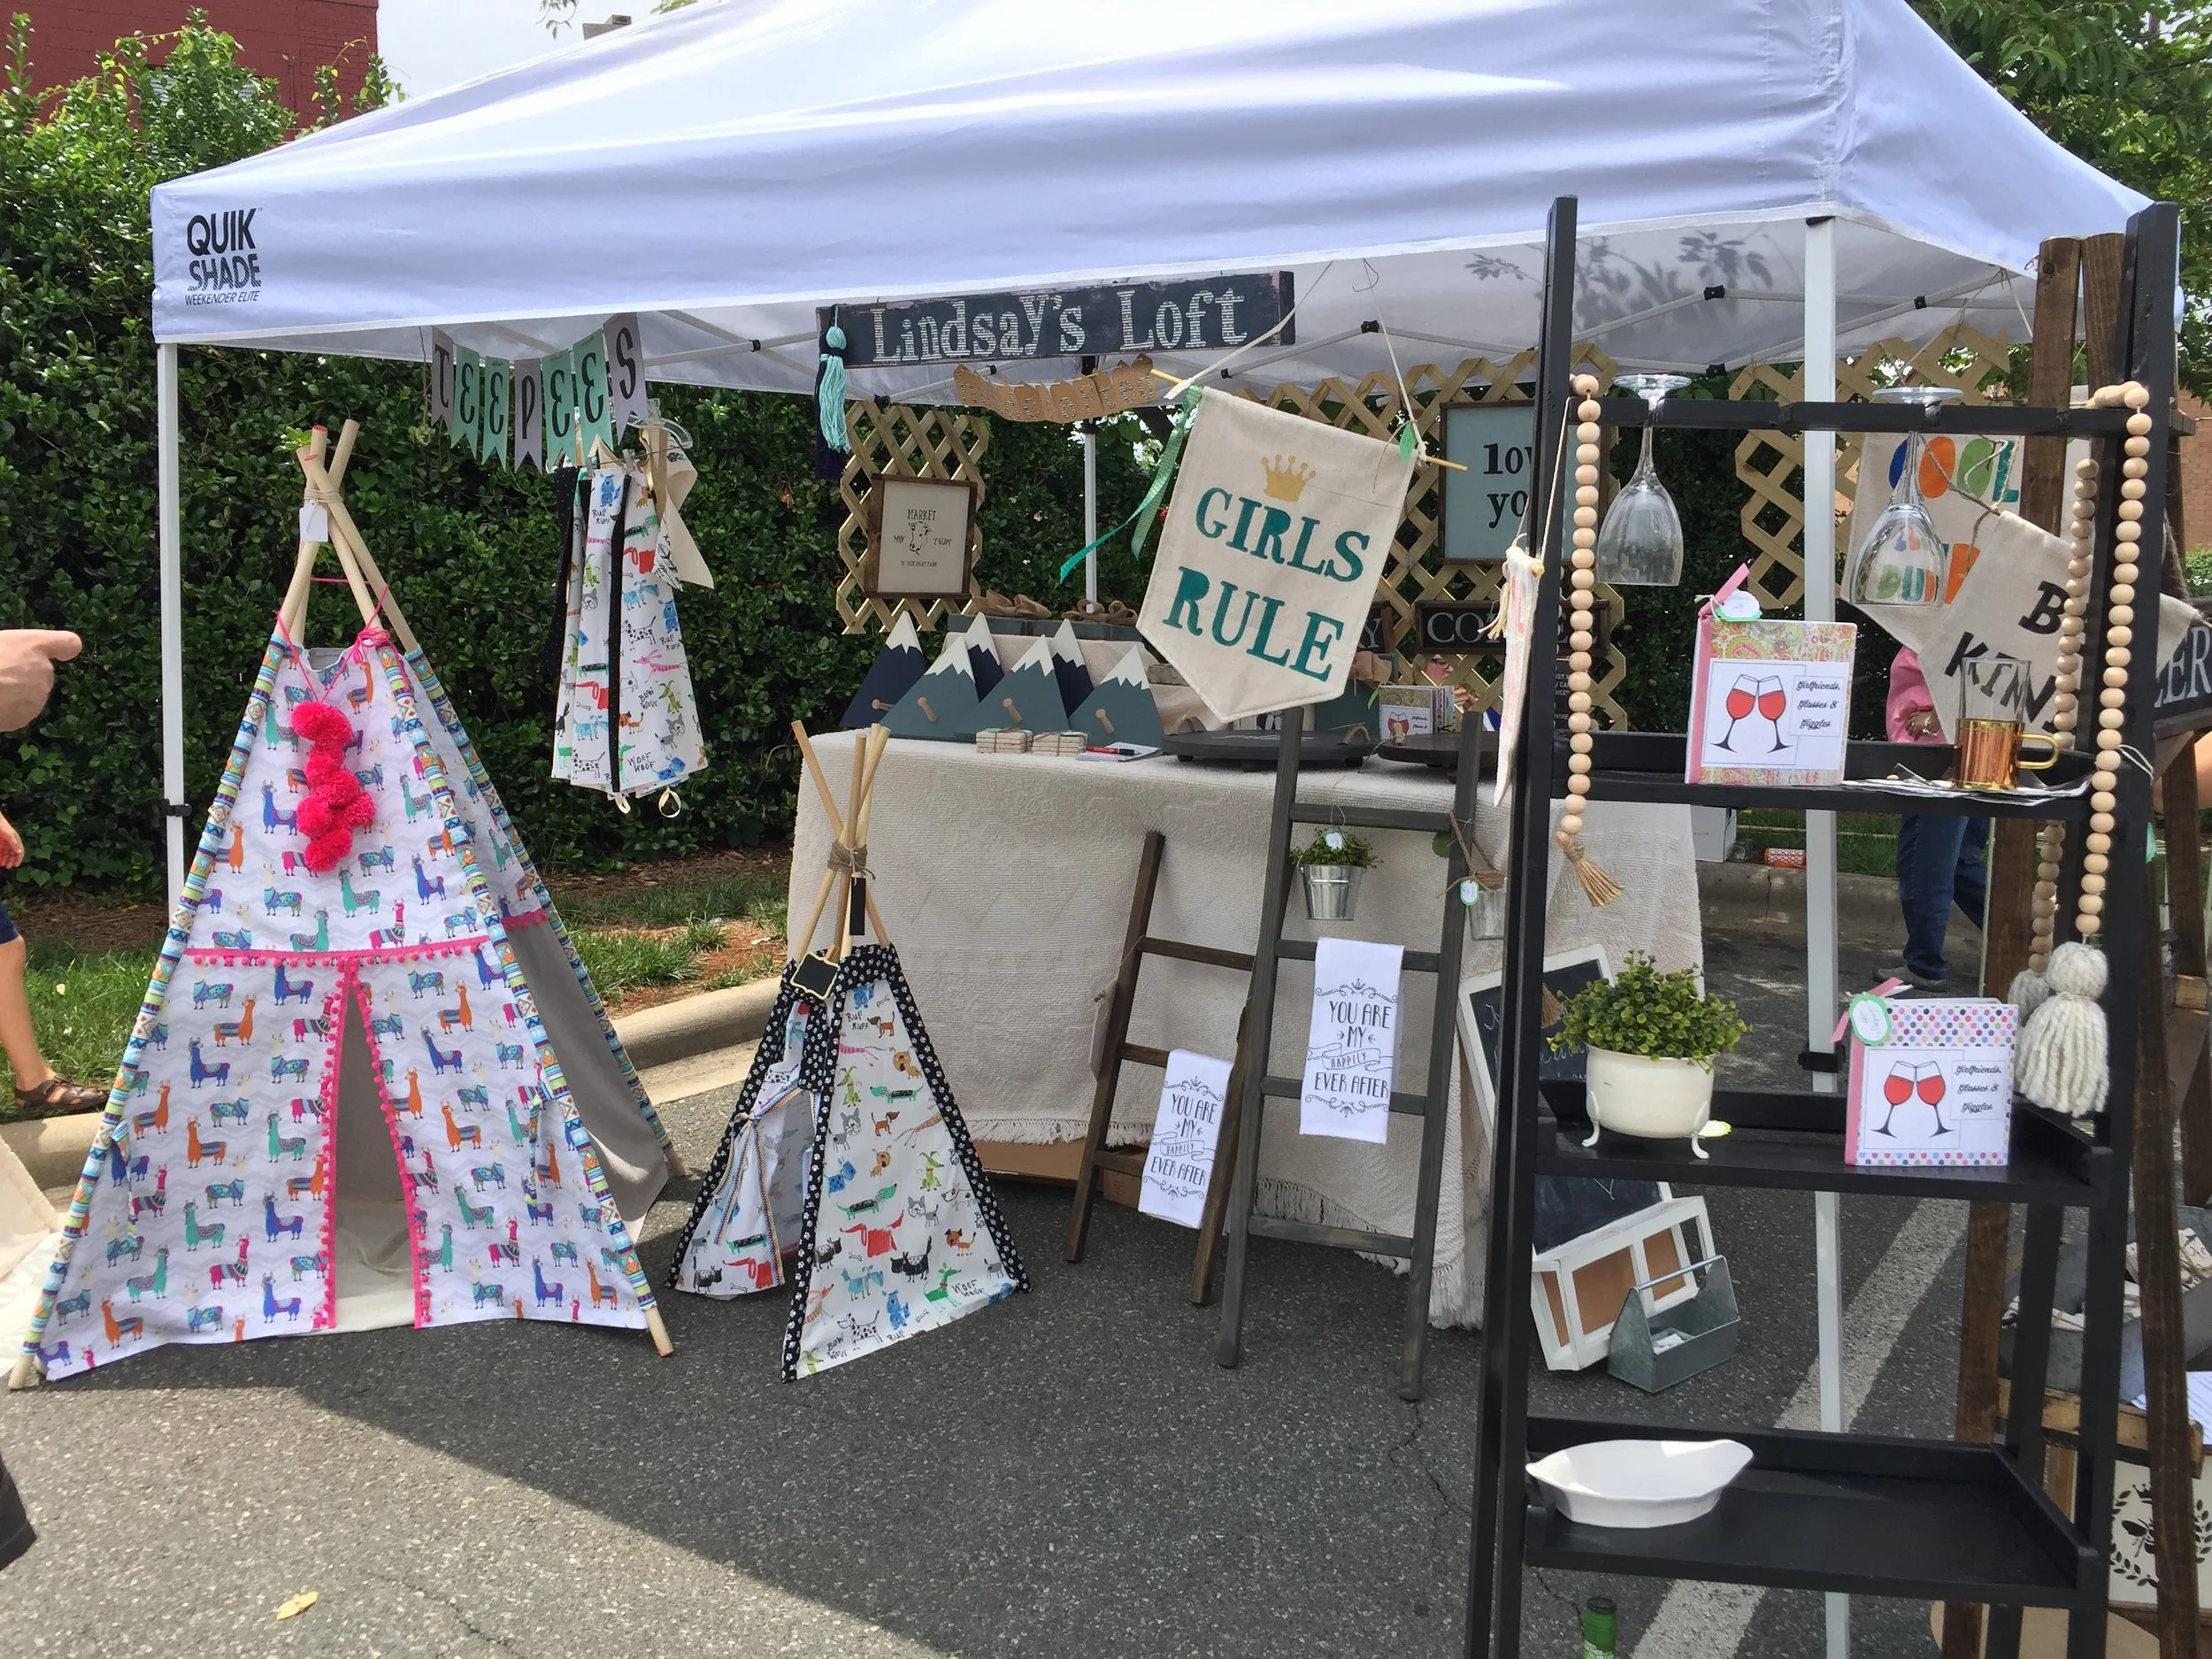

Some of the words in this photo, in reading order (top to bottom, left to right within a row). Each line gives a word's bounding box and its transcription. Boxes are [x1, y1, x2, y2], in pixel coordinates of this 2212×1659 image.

[187, 208, 257, 256] QUIK
[188, 253, 262, 292] SHADE
[185, 292, 237, 306] WEEKENDER
[238, 290, 260, 302] ELITE
[871, 293, 1087, 362] Lindsay's
[1117, 288, 1248, 350] Loft
[907, 509, 936, 521] MARKET
[1195, 487, 1371, 582] GIRLS
[1162, 565, 1345, 682] RULE
[659, 634, 674, 645] RUF
[1796, 680, 1840, 692] Girlfriends,
[1944, 631, 2081, 736] KIN
[638, 687, 654, 703] BOW
[641, 700, 657, 709] WOW
[1797, 700, 1827, 710] Glasses
[1830, 700, 1839, 709] &
[1800, 718, 1831, 730] Giggles
[627, 752, 651, 766] WOOF
[634, 761, 655, 772] WOOF
[846, 1011, 863, 1022] RUF
[1329, 1001, 1357, 1024] YOU
[1362, 1003, 1392, 1029] ARE
[1347, 1025, 1367, 1048] MY
[1331, 1051, 1366, 1069] HAPPILY
[1314, 1071, 1348, 1094] EVER
[1351, 1076, 1389, 1099] AFTER
[1957, 1083, 1988, 1094] Glasses
[1171, 1093, 1194, 1117] YOU
[1194, 1100, 1217, 1125] ARE
[1961, 1102, 1993, 1113] Giggles
[1181, 1118, 1197, 1139] MY
[1166, 1143, 1194, 1155] HAPPILY
[1150, 1156, 1176, 1177] EVER
[1177, 1164, 1206, 1187] AFTER
[951, 1279, 977, 1293] WOOF
[826, 1333, 844, 1352] BOW
[887, 1330, 904, 1342] RUF
